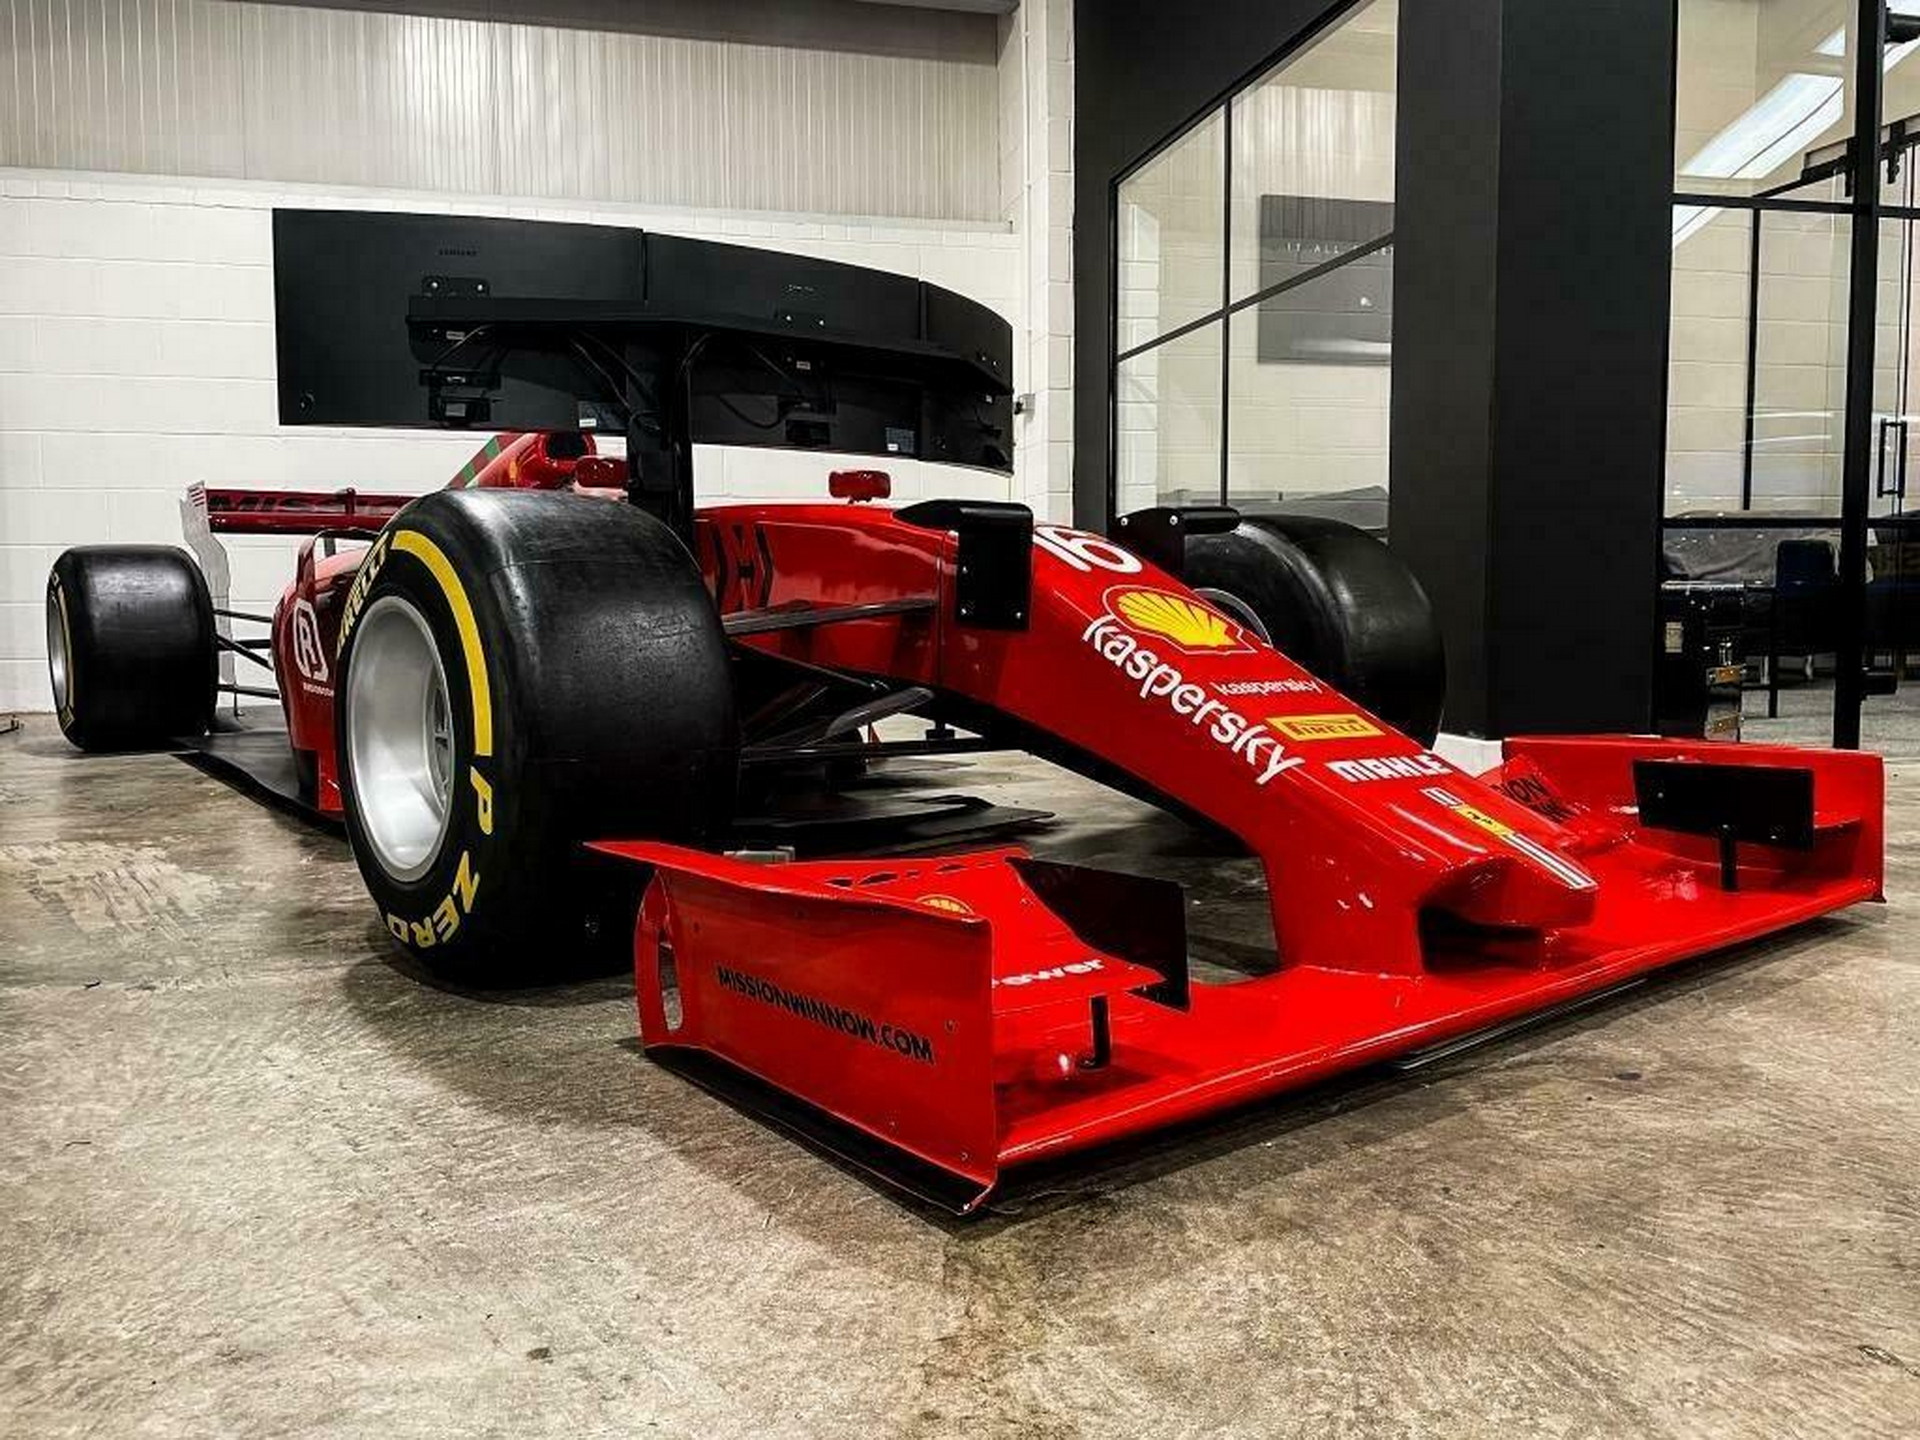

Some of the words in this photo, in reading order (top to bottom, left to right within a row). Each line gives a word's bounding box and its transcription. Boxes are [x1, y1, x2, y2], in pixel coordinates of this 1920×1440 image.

[1033, 526, 1143, 573] 16
[1082, 614, 1305, 785] kaspersky
[1209, 679, 1323, 697] kaspersky
[470, 765, 493, 835] P
[1323, 754, 1453, 783] MAHLE
[387, 850, 481, 948] ZERO
[715, 966, 935, 1065] MISSIONWINNOW.COM
